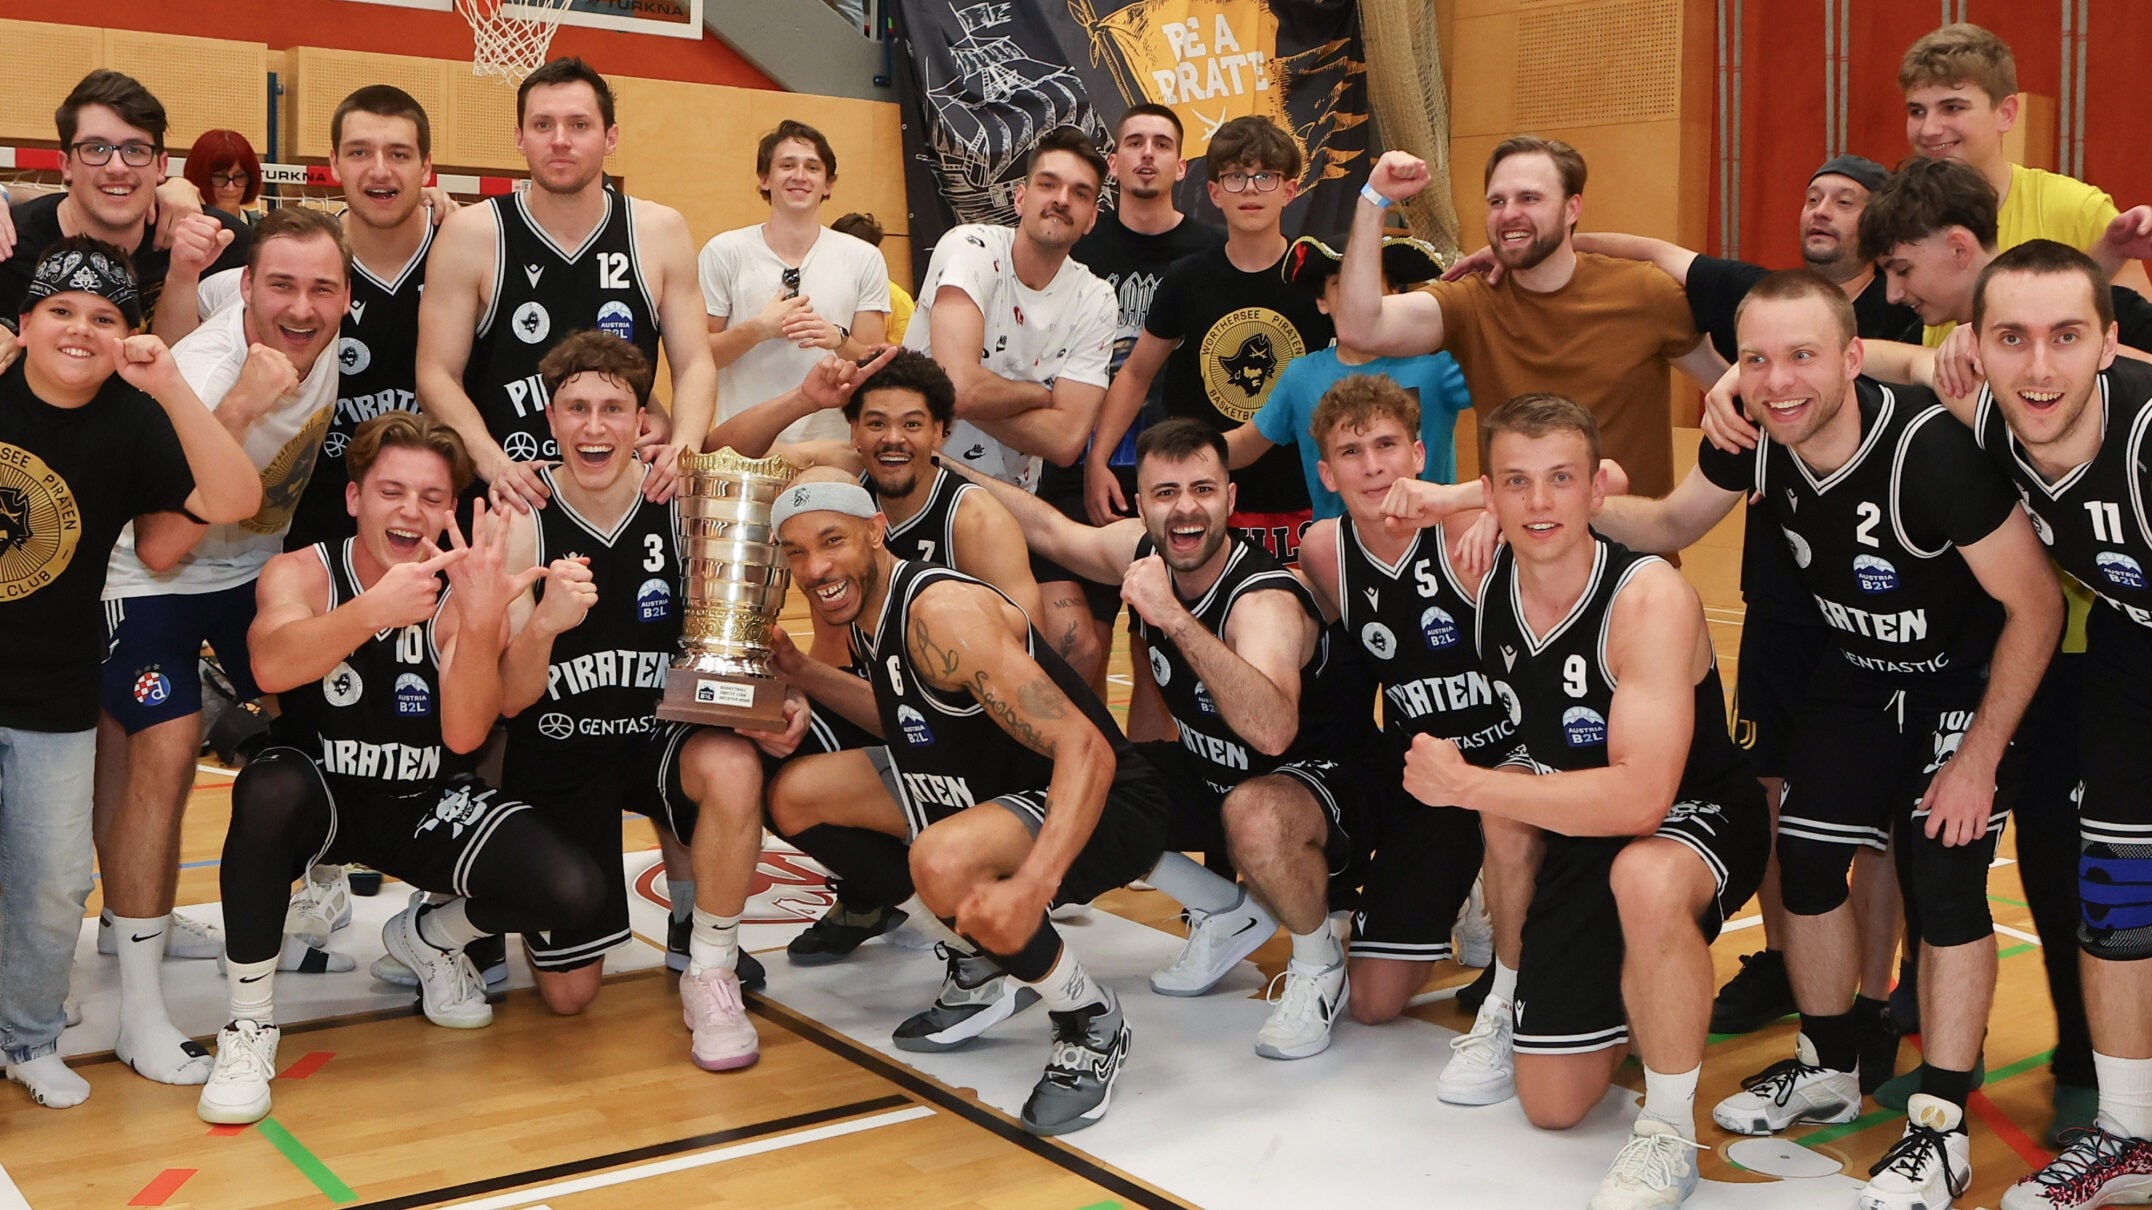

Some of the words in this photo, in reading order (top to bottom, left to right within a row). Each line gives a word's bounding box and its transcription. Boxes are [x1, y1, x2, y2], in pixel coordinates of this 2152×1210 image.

[1214, 14, 1240, 54] A
[596, 252, 630, 289] 12
[1271, 315, 1303, 355] PIRATEN
[334, 389, 419, 425] PIRAT
[1209, 389, 1255, 420] BASKETB
[42, 474, 77, 530] PIRATEN
[1856, 501, 1881, 548] 2
[2084, 501, 2125, 544] 11
[643, 533, 665, 572] 3
[917, 540, 936, 562] 7
[7, 570, 50, 597] CLUB
[1414, 558, 1438, 598] 5
[1858, 573, 1894, 581] AUSTRIA
[1862, 580, 1894, 591] B2L
[641, 599, 668, 607] AUSTRIA
[643, 606, 667, 618] B2L
[1814, 593, 1928, 643] RATEN
[396, 624, 423, 664] 10
[1427, 626, 1454, 636] AUSTRIA
[1430, 633, 1455, 646] B2L
[886, 655, 904, 696] 6
[1563, 654, 1588, 698] 9
[1843, 650, 1949, 673] ENTASTIC
[399, 701, 426, 712] B2L
[579, 715, 656, 735] GENTAS
[907, 731, 928, 743] B2L
[1450, 719, 1515, 750] TASTIC
[1568, 726, 1604, 734] AUSTRIA
[1572, 733, 1603, 744] B2L
[1173, 715, 1248, 770] ATEN
[319, 735, 441, 782] IRATEN
